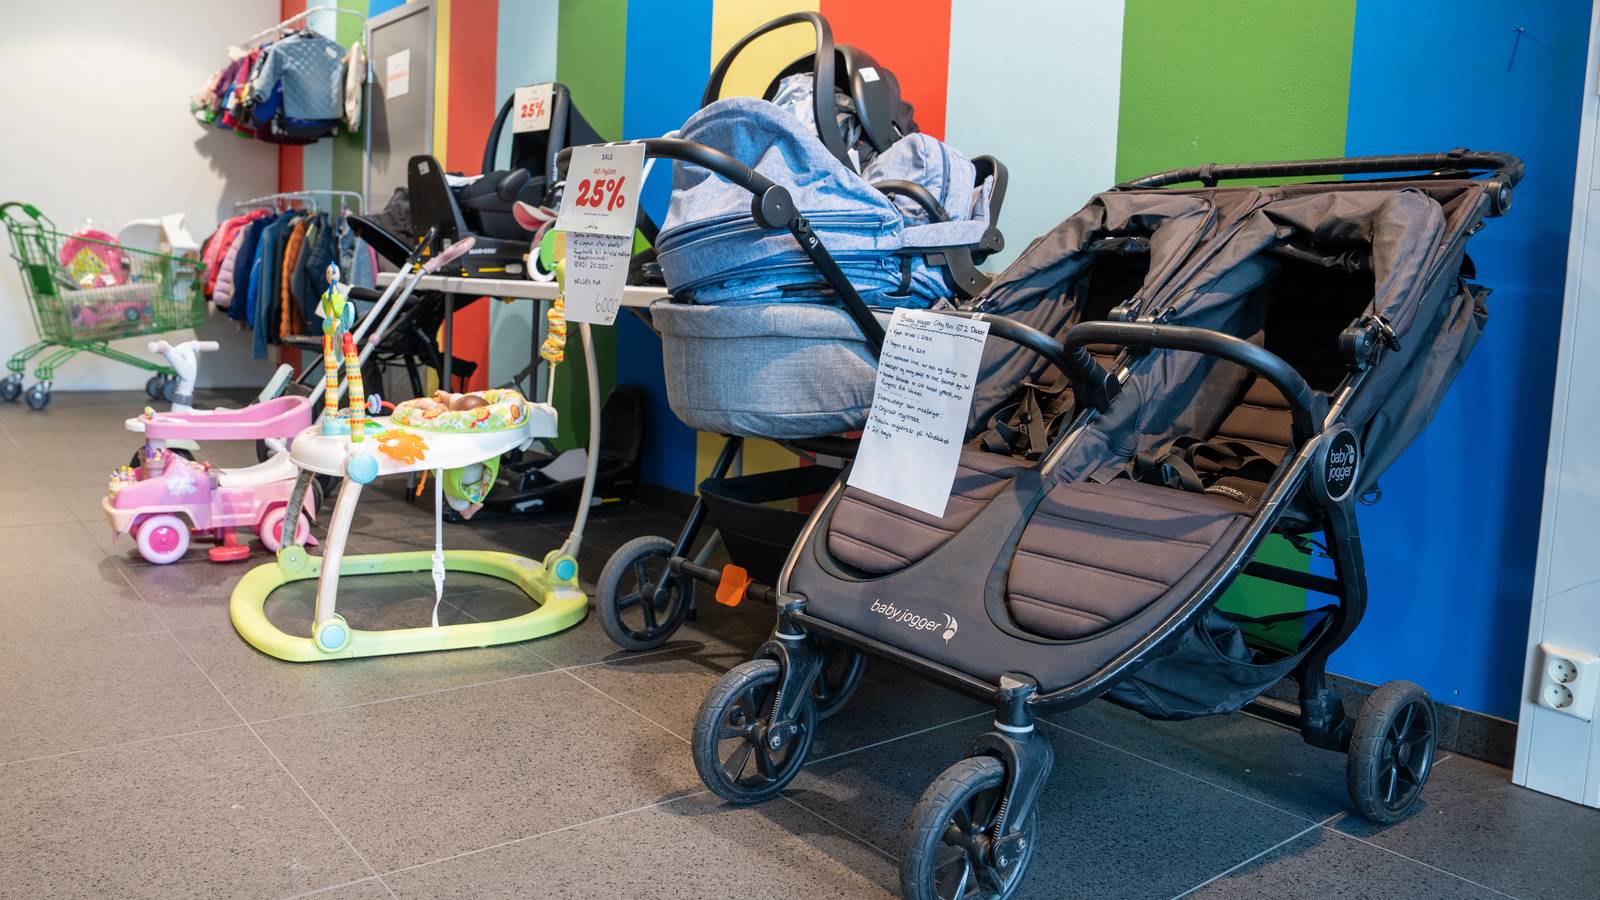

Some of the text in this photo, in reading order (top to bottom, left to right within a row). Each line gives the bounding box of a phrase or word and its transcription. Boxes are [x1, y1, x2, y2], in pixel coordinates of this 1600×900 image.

[521, 101, 545, 118] 25%
[575, 176, 625, 212] 25%
[933, 319, 944, 331] City
[1330, 448, 1348, 466] baby
[1327, 464, 1352, 482] jogger
[870, 598, 942, 632] baby jogger
